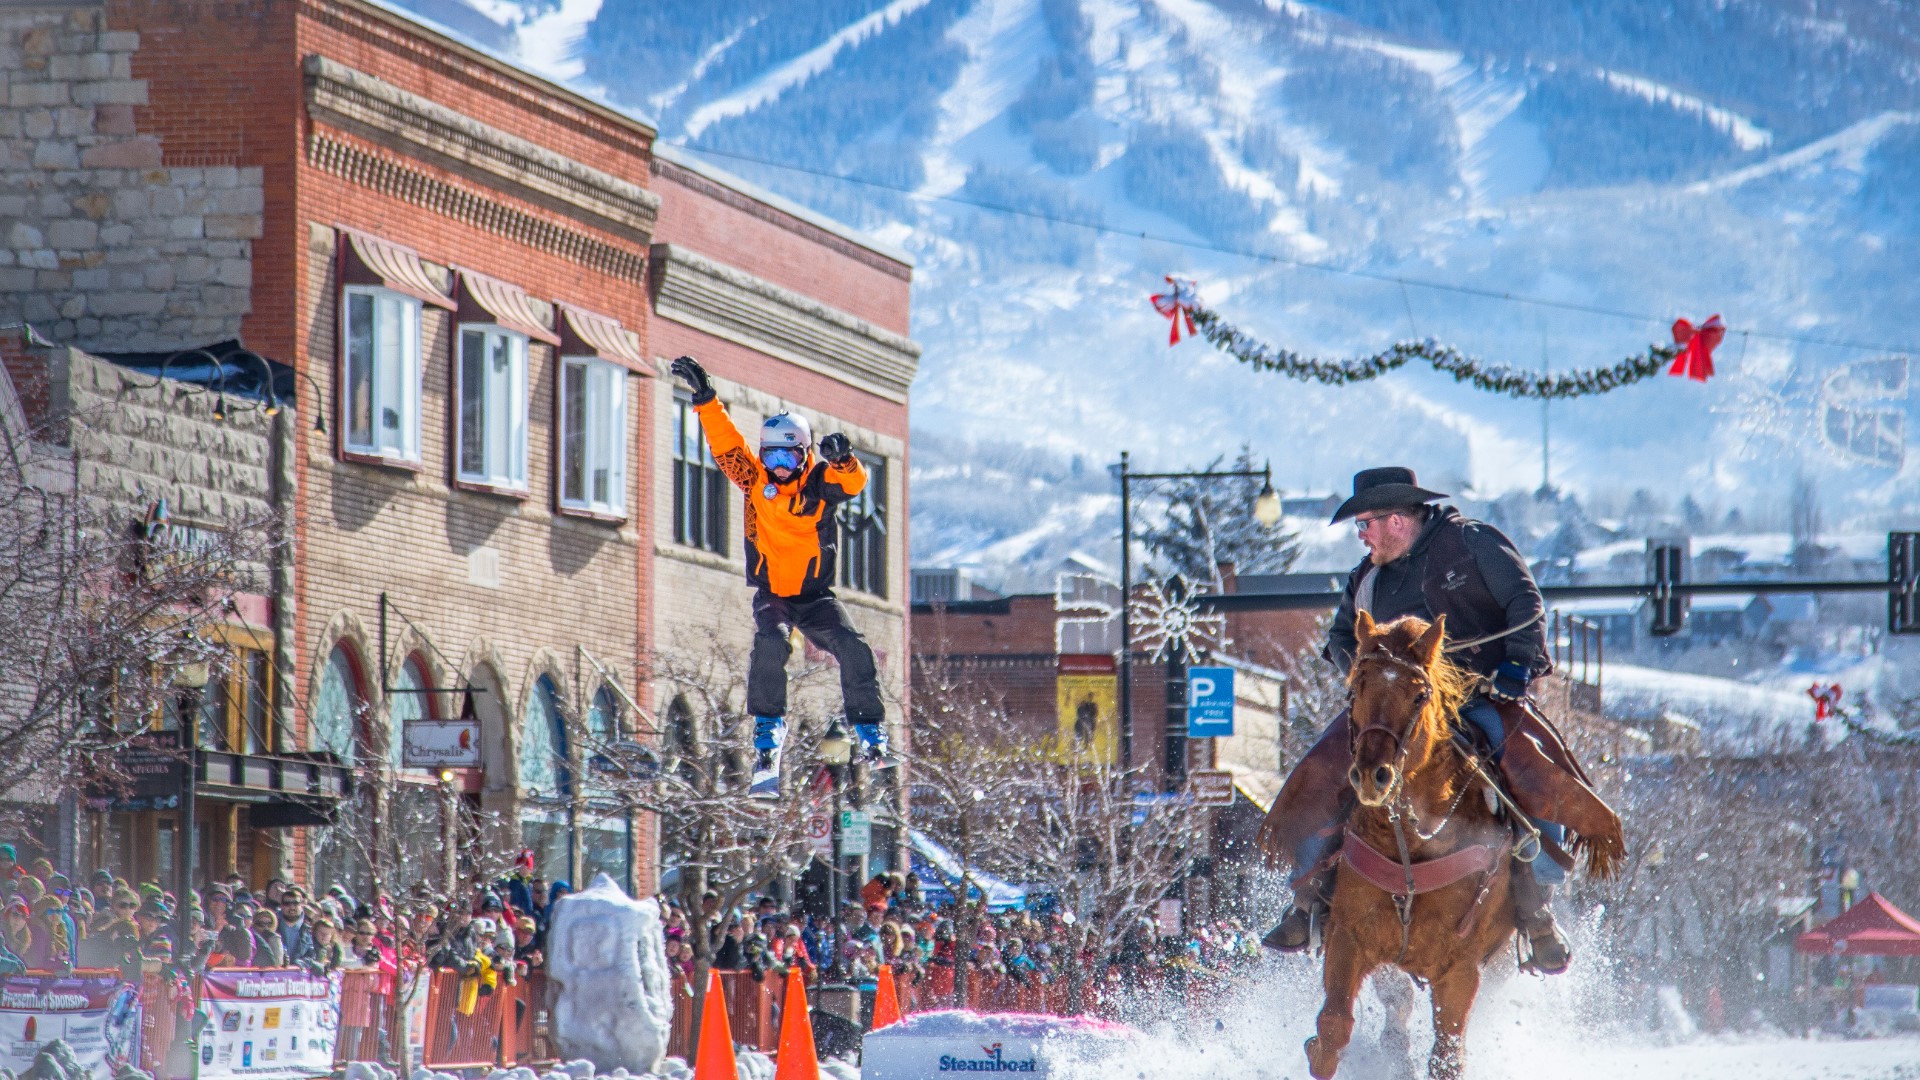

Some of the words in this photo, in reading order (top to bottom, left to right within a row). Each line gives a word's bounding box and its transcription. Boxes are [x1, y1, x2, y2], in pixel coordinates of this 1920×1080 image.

[411, 745, 465, 759] Chrysalis
[132, 764, 169, 774] SPECIALS
[2, 988, 48, 1013] Presenting
[48, 992, 90, 1012] Sponsors
[939, 1048, 1036, 1072] Steamboat
